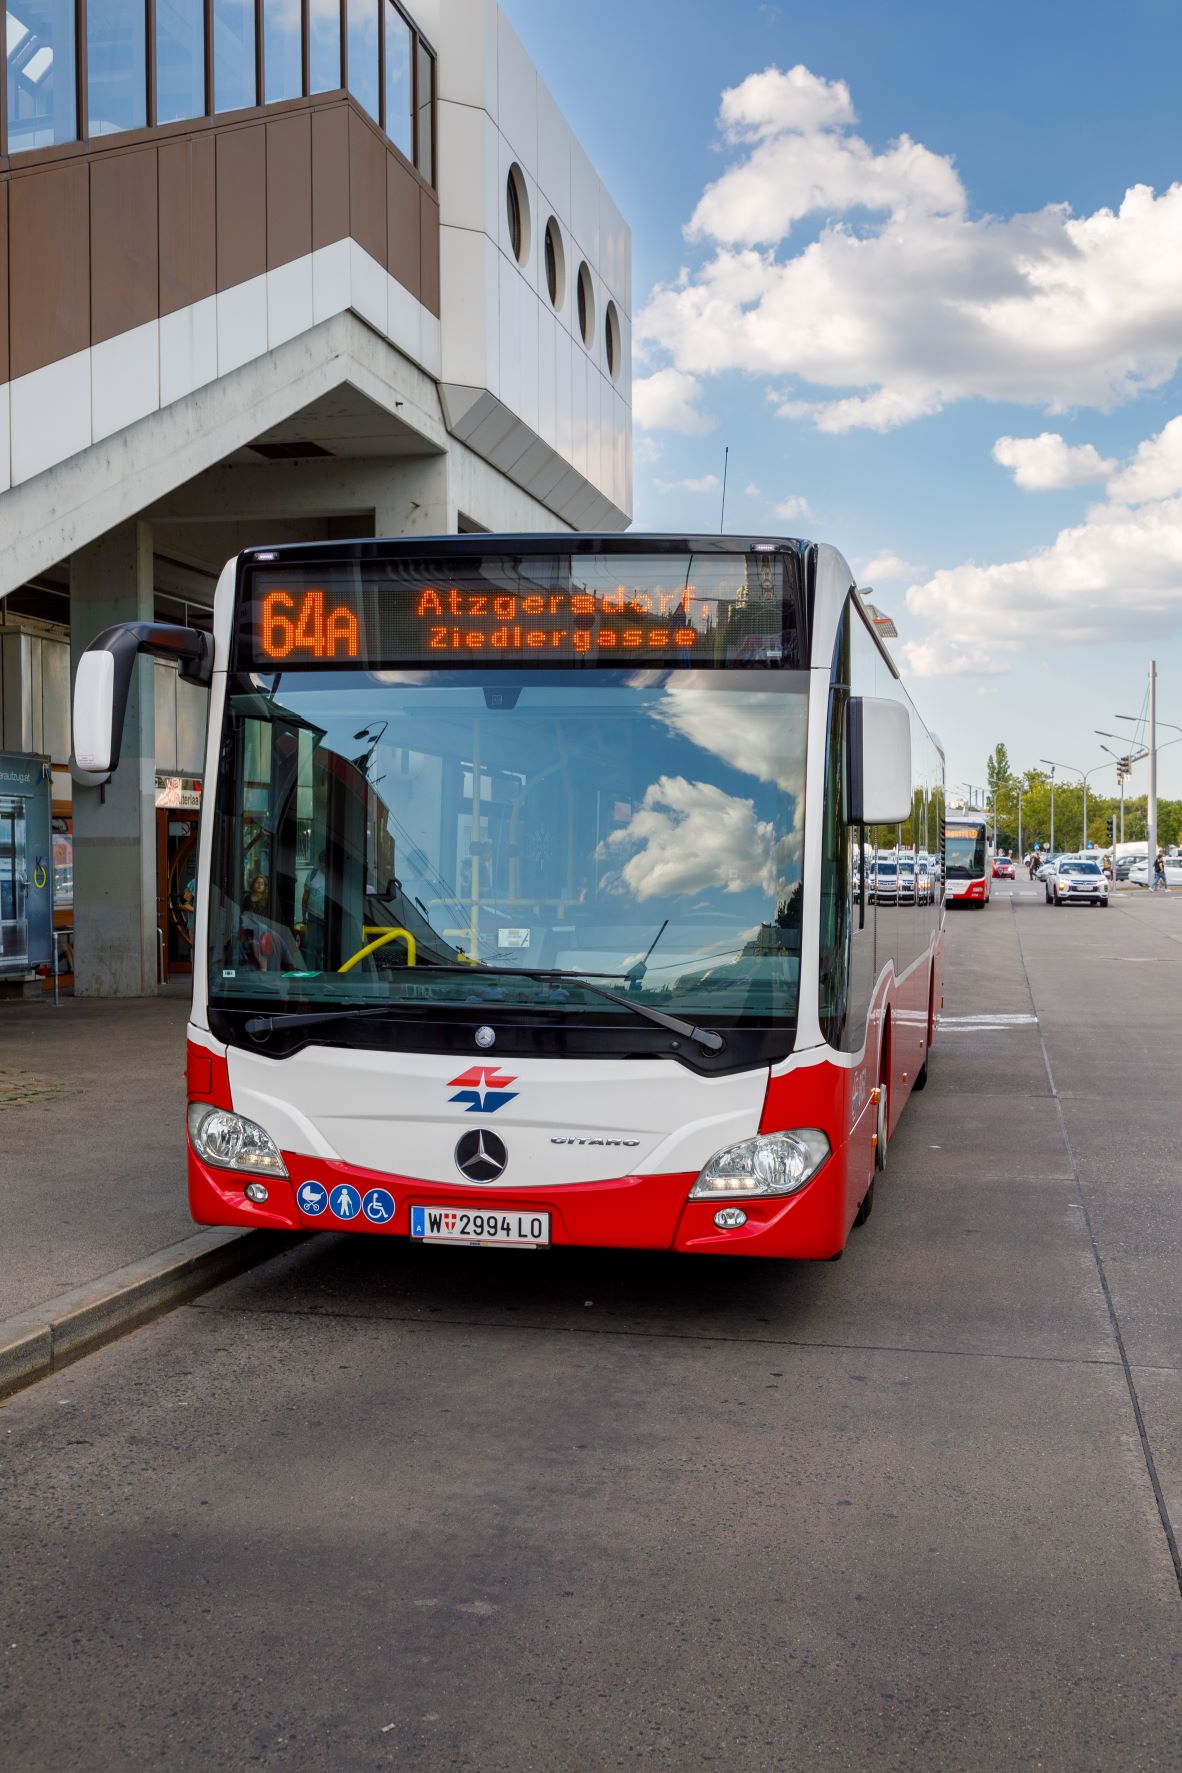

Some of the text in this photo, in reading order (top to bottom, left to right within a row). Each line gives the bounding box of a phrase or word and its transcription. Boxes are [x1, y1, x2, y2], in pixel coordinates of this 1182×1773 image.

[417, 584, 709, 620] Atzgersdorf,
[262, 592, 358, 657] 64A
[430, 625, 696, 652] Ziedlergasse
[550, 1136, 641, 1147] CITARO
[428, 1212, 542, 1239] W 2994 LO
